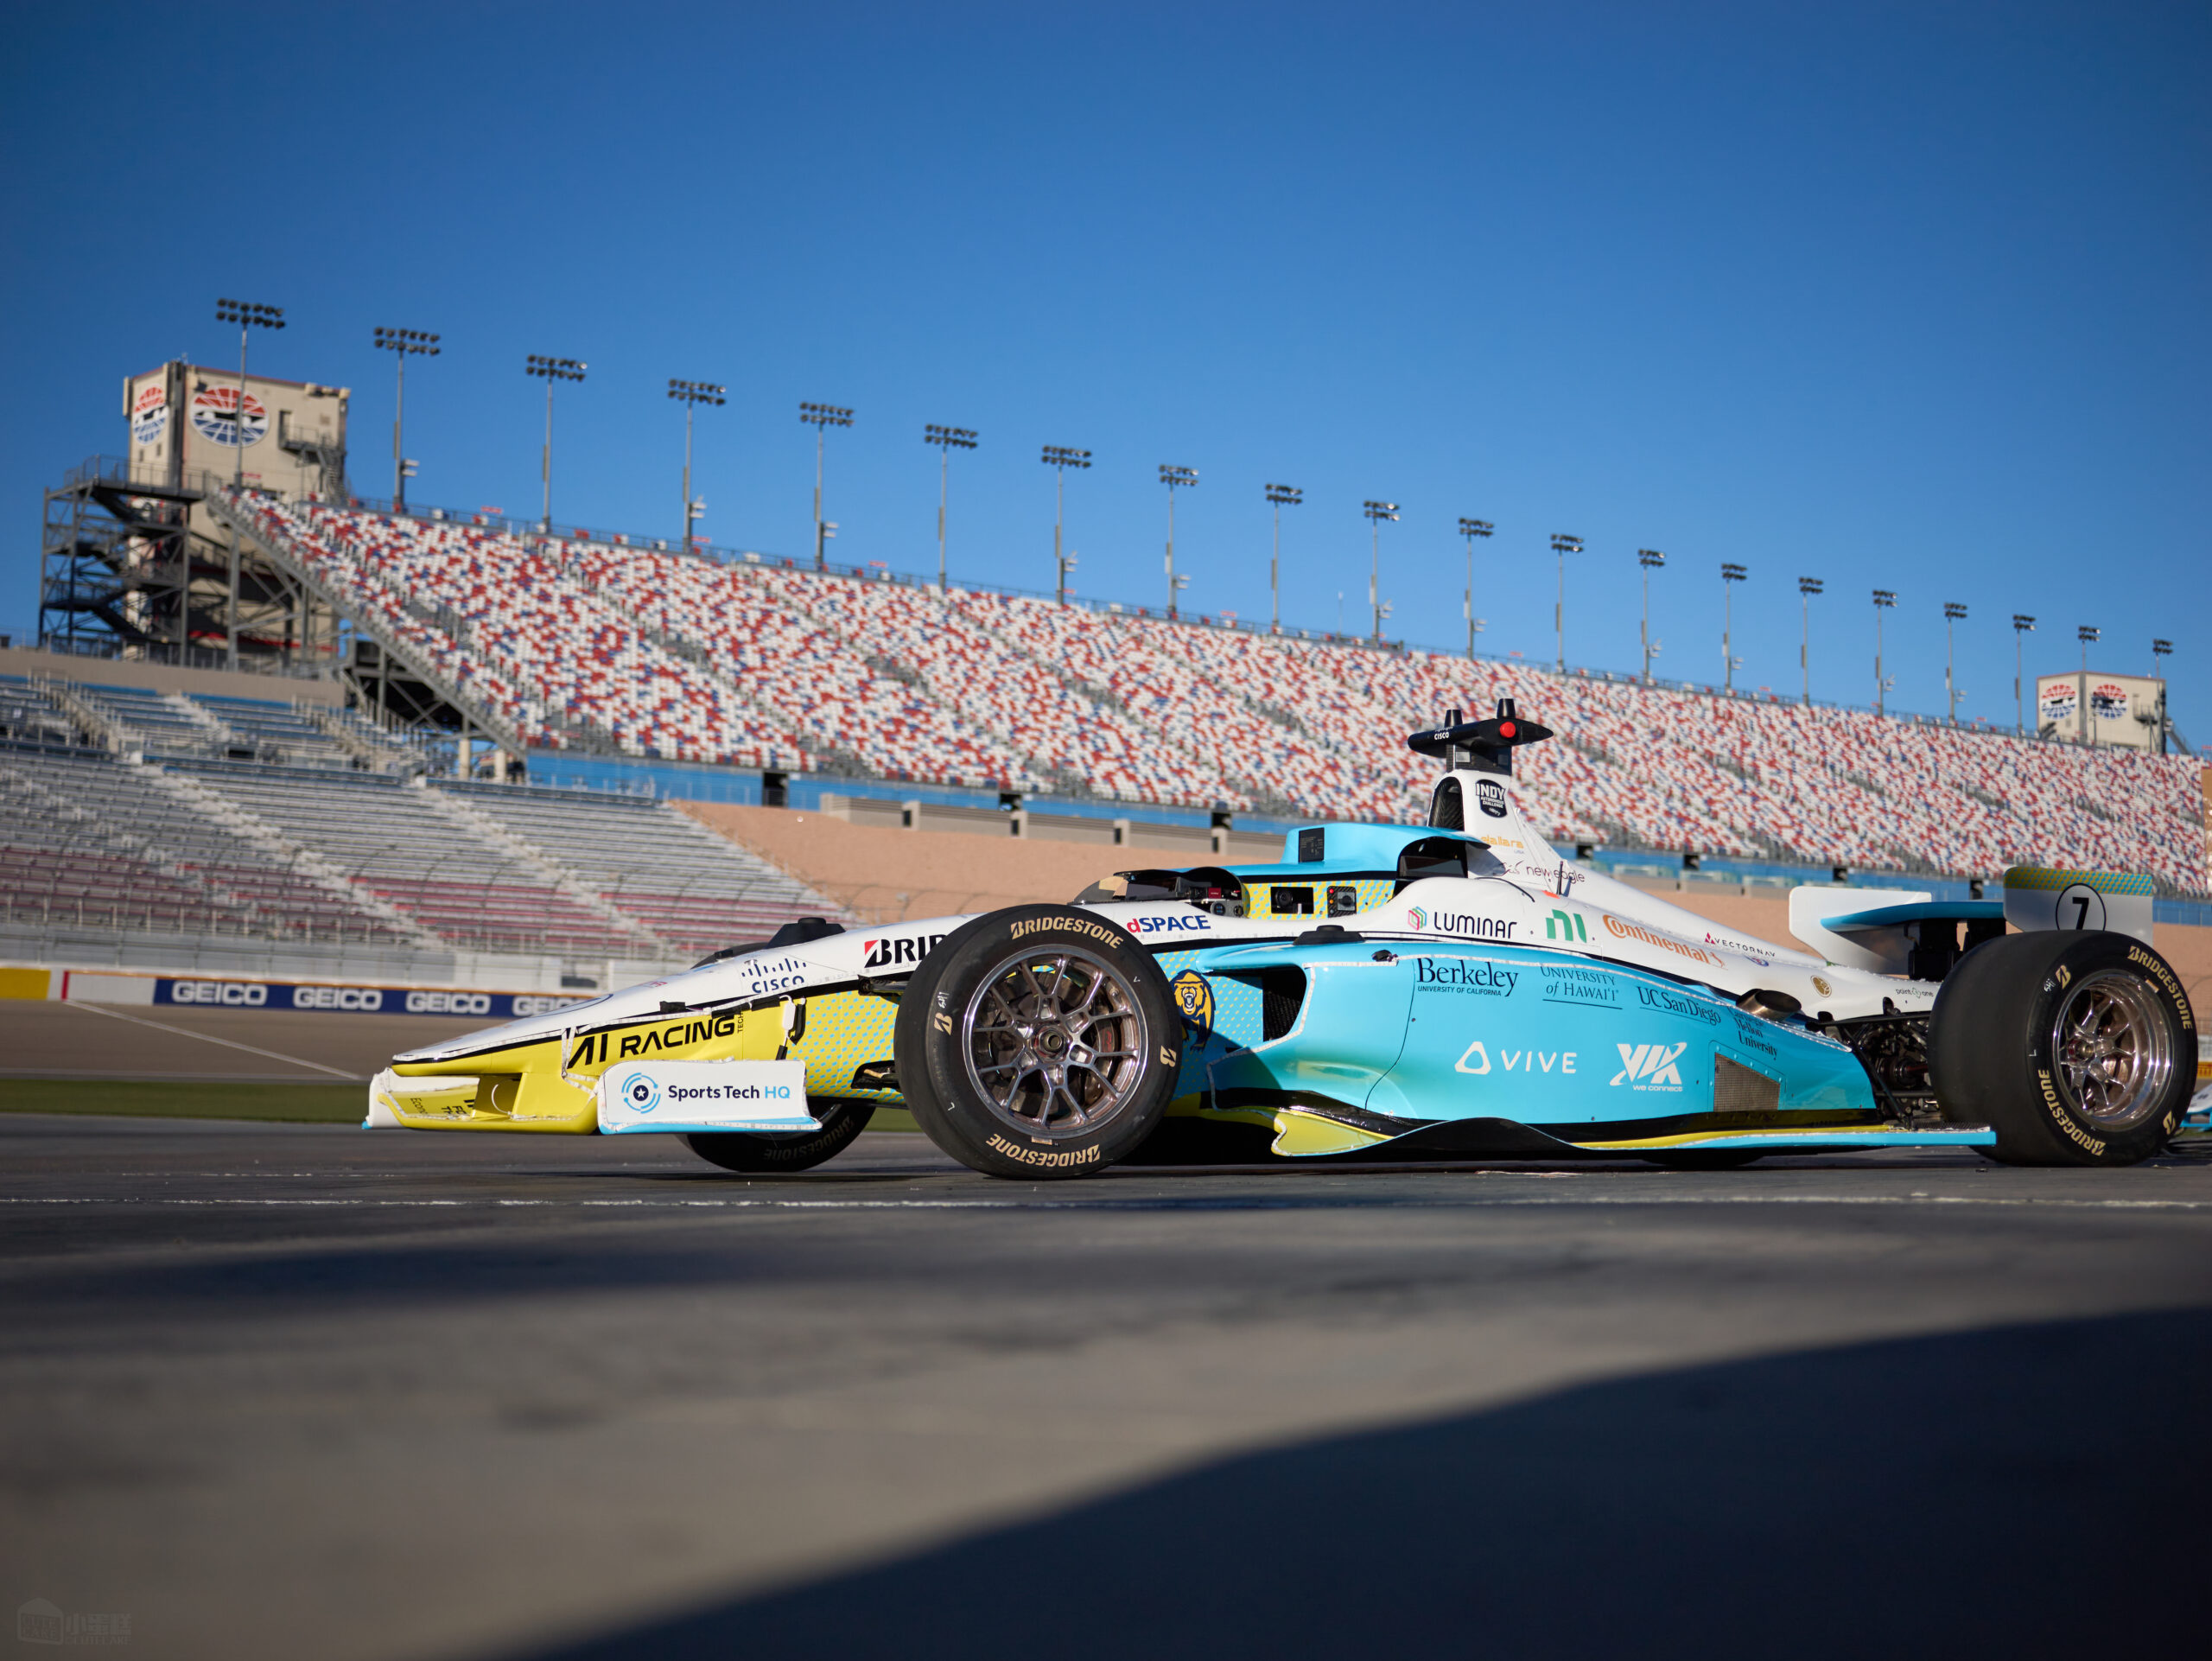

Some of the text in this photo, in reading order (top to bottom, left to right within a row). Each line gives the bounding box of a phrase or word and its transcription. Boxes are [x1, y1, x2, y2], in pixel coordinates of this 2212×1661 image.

[1433, 732, 1450, 741] CISCO
[1476, 783, 1504, 800] INDY
[1526, 866, 1585, 884] new eagle
[1126, 915, 1211, 933] dSPACE
[2072, 896, 2089, 930] 7
[1010, 916, 1124, 950] BRIDGESTONE
[1602, 914, 1711, 964] Continental
[1714, 938, 1776, 958] VECTORNAV
[752, 975, 804, 993] CISCO
[1416, 958, 1519, 997] Berkeley
[1540, 966, 1615, 985] UNIVERSITY
[2127, 945, 2193, 1030] BRIDGESTONE
[172, 981, 268, 1006] GEICO
[293, 985, 382, 1011] GEICO
[1466, 988, 1502, 996] CALIFORNIA
[1546, 982, 1559, 996] of
[405, 991, 491, 1015] GEICO
[1637, 986, 1721, 1026] UC San Diego
[620, 1015, 735, 1059] RACING
[1738, 1030, 1778, 1061] University
[1500, 1049, 1578, 1073] VIVE
[668, 1085, 791, 1102] Sports Tech HQ
[2037, 1068, 2107, 1156] BRIDGESTONE
[985, 1133, 1101, 1168] BRIDGESTONE
